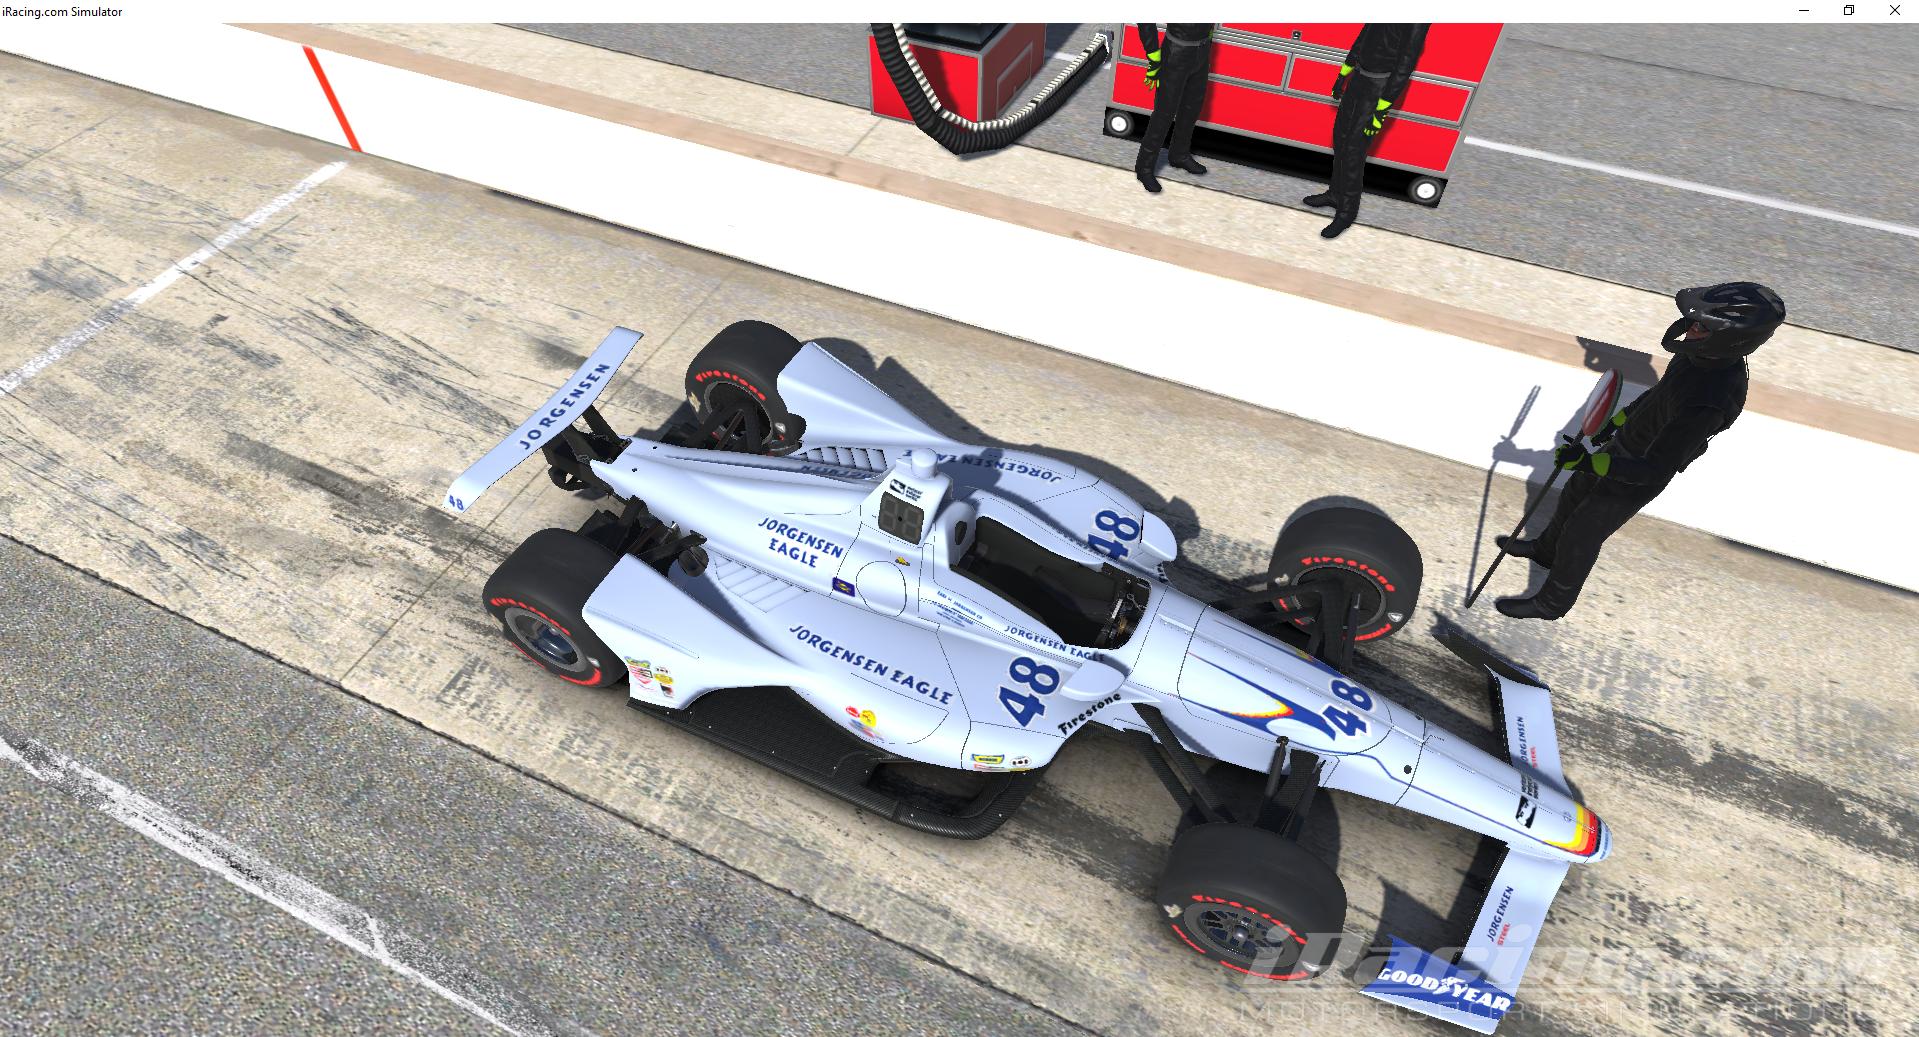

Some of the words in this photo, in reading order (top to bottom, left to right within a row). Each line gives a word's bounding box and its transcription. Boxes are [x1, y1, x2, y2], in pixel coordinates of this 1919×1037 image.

[2, 6, 68, 19] iRacing.com
[71, 6, 123, 17] Simulator
[519, 364, 611, 450] JORGENSEN
[960, 458, 1062, 483] JORGENSEN
[449, 494, 465, 511] 48
[758, 517, 844, 559] JORGENSEN
[768, 538, 819, 569] EAGLE
[1087, 509, 1141, 560] 48
[1004, 625, 1067, 652] JORGENSEN
[1070, 647, 1105, 662] EAGLE
[789, 624, 889, 681] JORGENSEN
[889, 670, 954, 706] EAGLE
[998, 656, 1061, 727] 48
[1322, 680, 1373, 736] 48
[1058, 693, 1121, 735] Firestone
[1487, 886, 1514, 942] JORGENSEN
